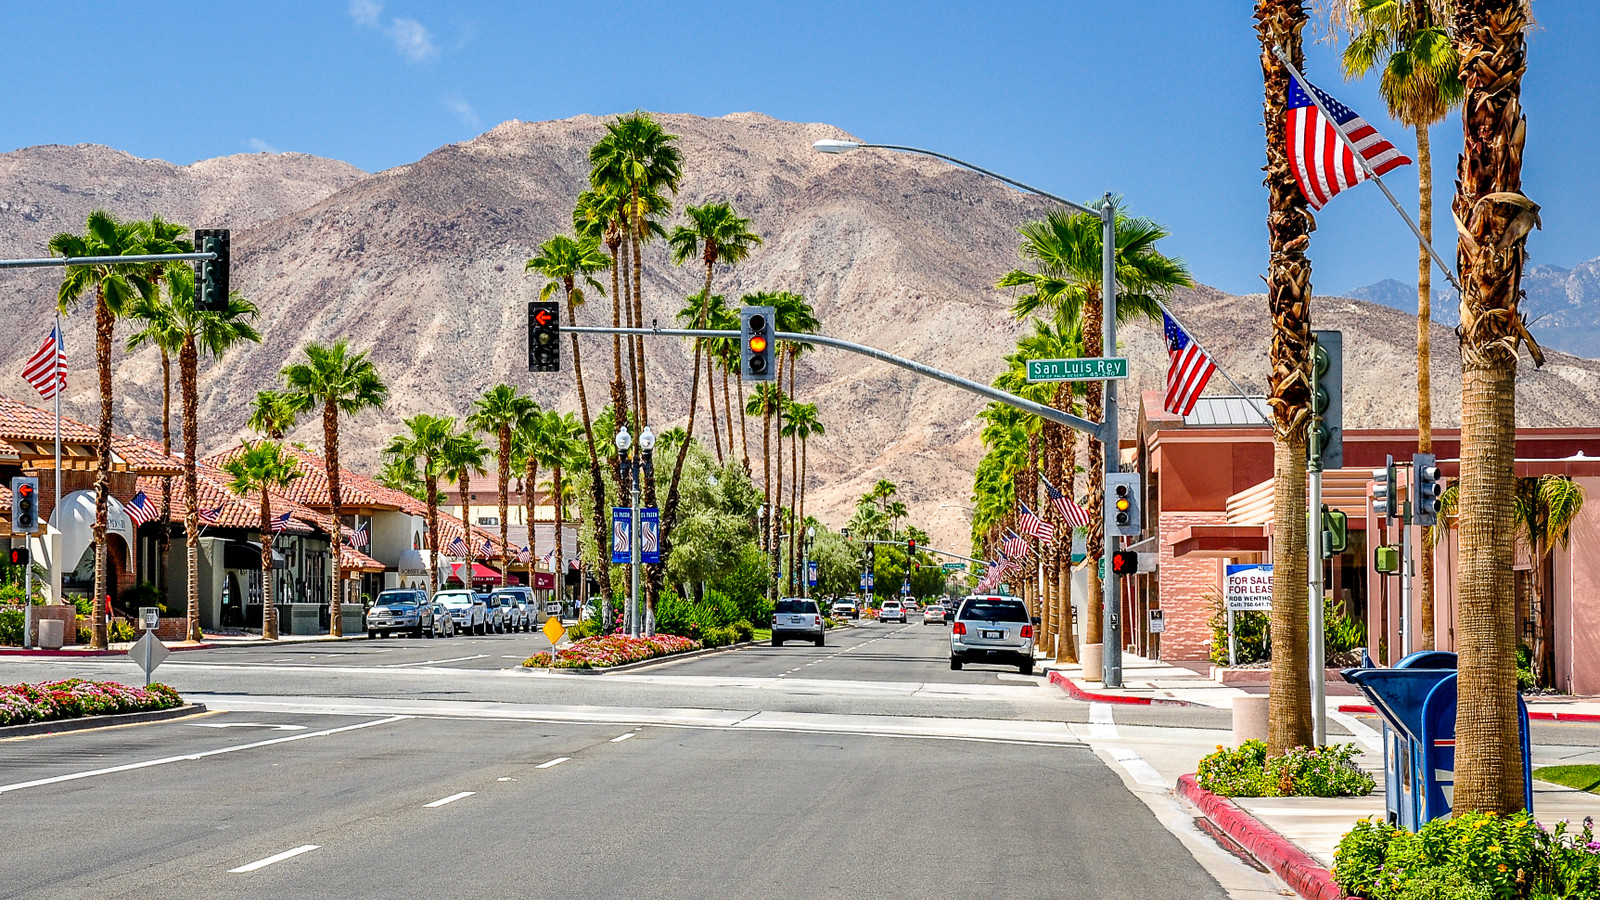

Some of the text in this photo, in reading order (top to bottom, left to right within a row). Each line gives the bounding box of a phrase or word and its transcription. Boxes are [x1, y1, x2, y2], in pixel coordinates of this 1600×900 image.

[1034, 360, 1121, 375] San Luis Rey
[1229, 576, 1274, 585] FOR SALE
[1229, 586, 1273, 594] FOR LEAS
